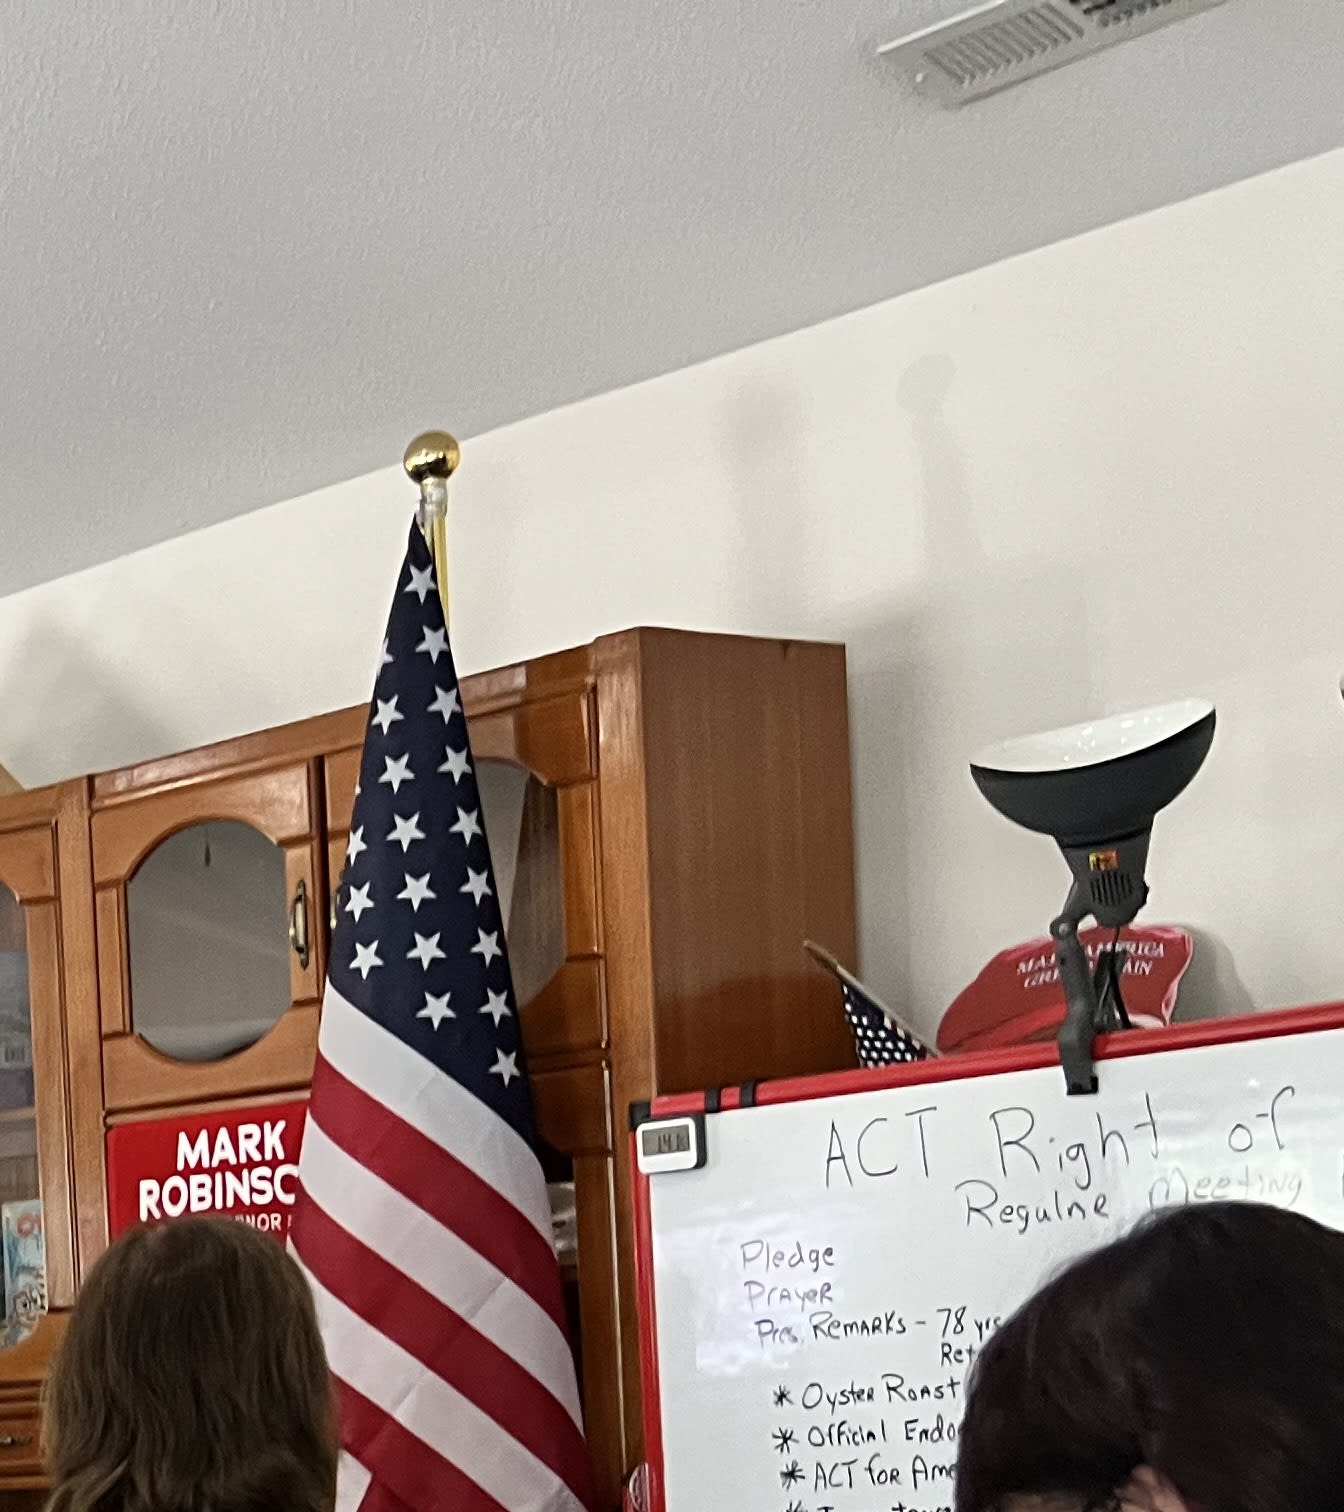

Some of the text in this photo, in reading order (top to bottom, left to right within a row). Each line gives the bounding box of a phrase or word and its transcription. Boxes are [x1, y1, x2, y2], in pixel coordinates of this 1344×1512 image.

[176, 1120, 286, 1171] MARK
[825, 1086, 1295, 1190] ACT Right of
[139, 1163, 299, 1222] ROBINSO
[740, 1240, 835, 1273] Pledge
[936, 1306, 967, 1338] 78
[904, 1413, 962, 1444] Endo
[814, 1458, 859, 1492] ACT
